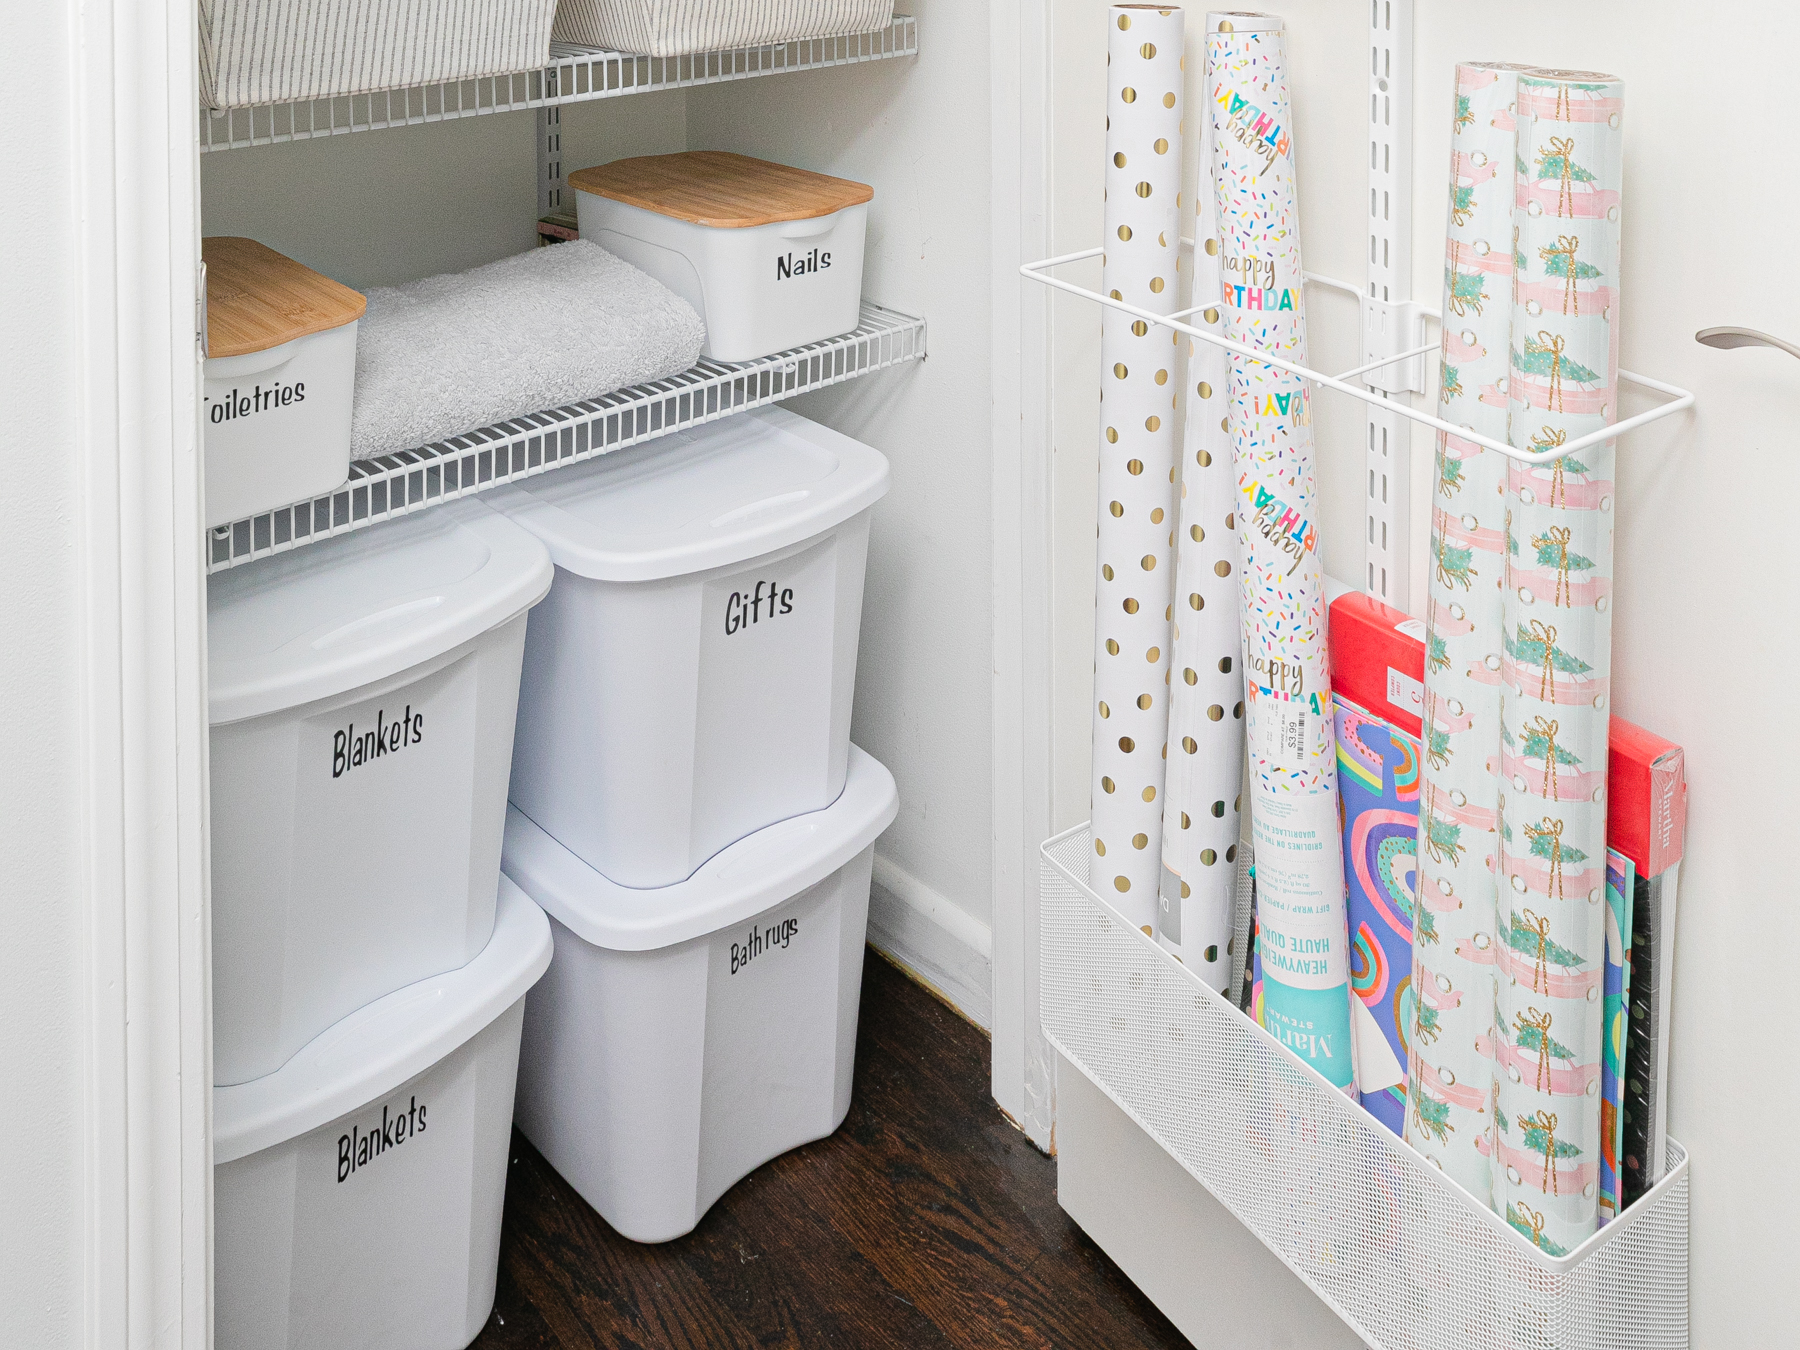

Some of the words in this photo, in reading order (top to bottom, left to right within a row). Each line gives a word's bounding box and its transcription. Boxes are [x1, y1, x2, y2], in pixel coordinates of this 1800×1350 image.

[1226, 107, 1280, 177] happy
[777, 247, 832, 281] Nails
[1221, 237, 1276, 291] happy
[1252, 502, 1307, 577] happy
[725, 580, 794, 636] Gifts
[1245, 635, 1304, 697] happy
[333, 704, 423, 779] Blankets
[1288, 722, 1298, 749] $3.99
[1271, 826, 1316, 838] QUADRILLAGE
[1662, 779, 1675, 849] Martha
[1276, 840, 1286, 849] ON
[1288, 842, 1323, 851] GRIDLINES
[1292, 905, 1314, 914] WRAP
[1316, 904, 1330, 914] GIFT
[731, 924, 762, 976] Bath
[765, 918, 799, 949] rugs
[1290, 937, 1330, 954] HAUTE
[337, 1096, 427, 1184] Blankets
